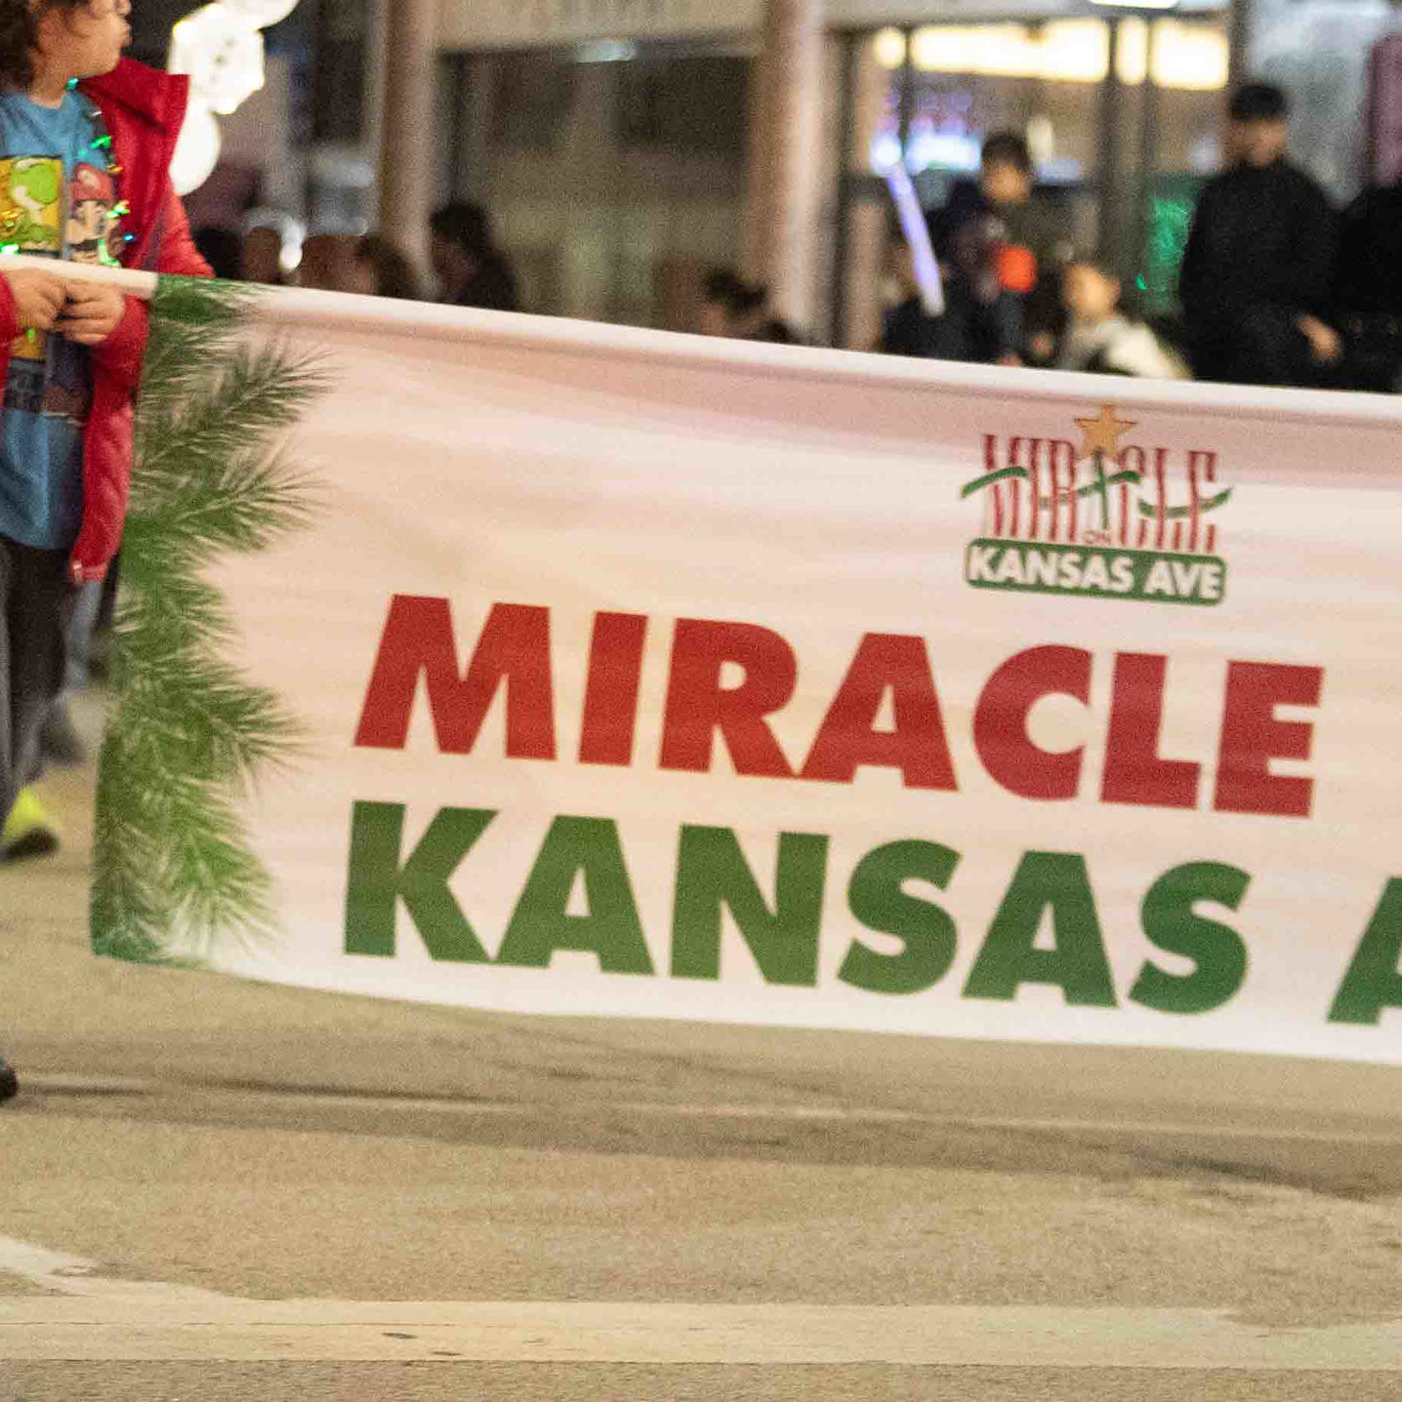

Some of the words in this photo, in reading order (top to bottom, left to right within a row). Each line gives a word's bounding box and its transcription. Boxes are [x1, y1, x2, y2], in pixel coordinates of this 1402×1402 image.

[967, 546, 1135, 593] KANSAS
[1143, 561, 1225, 598] AVE
[353, 593, 1325, 818] MIRACLE
[344, 799, 1253, 1014] KANSAS
